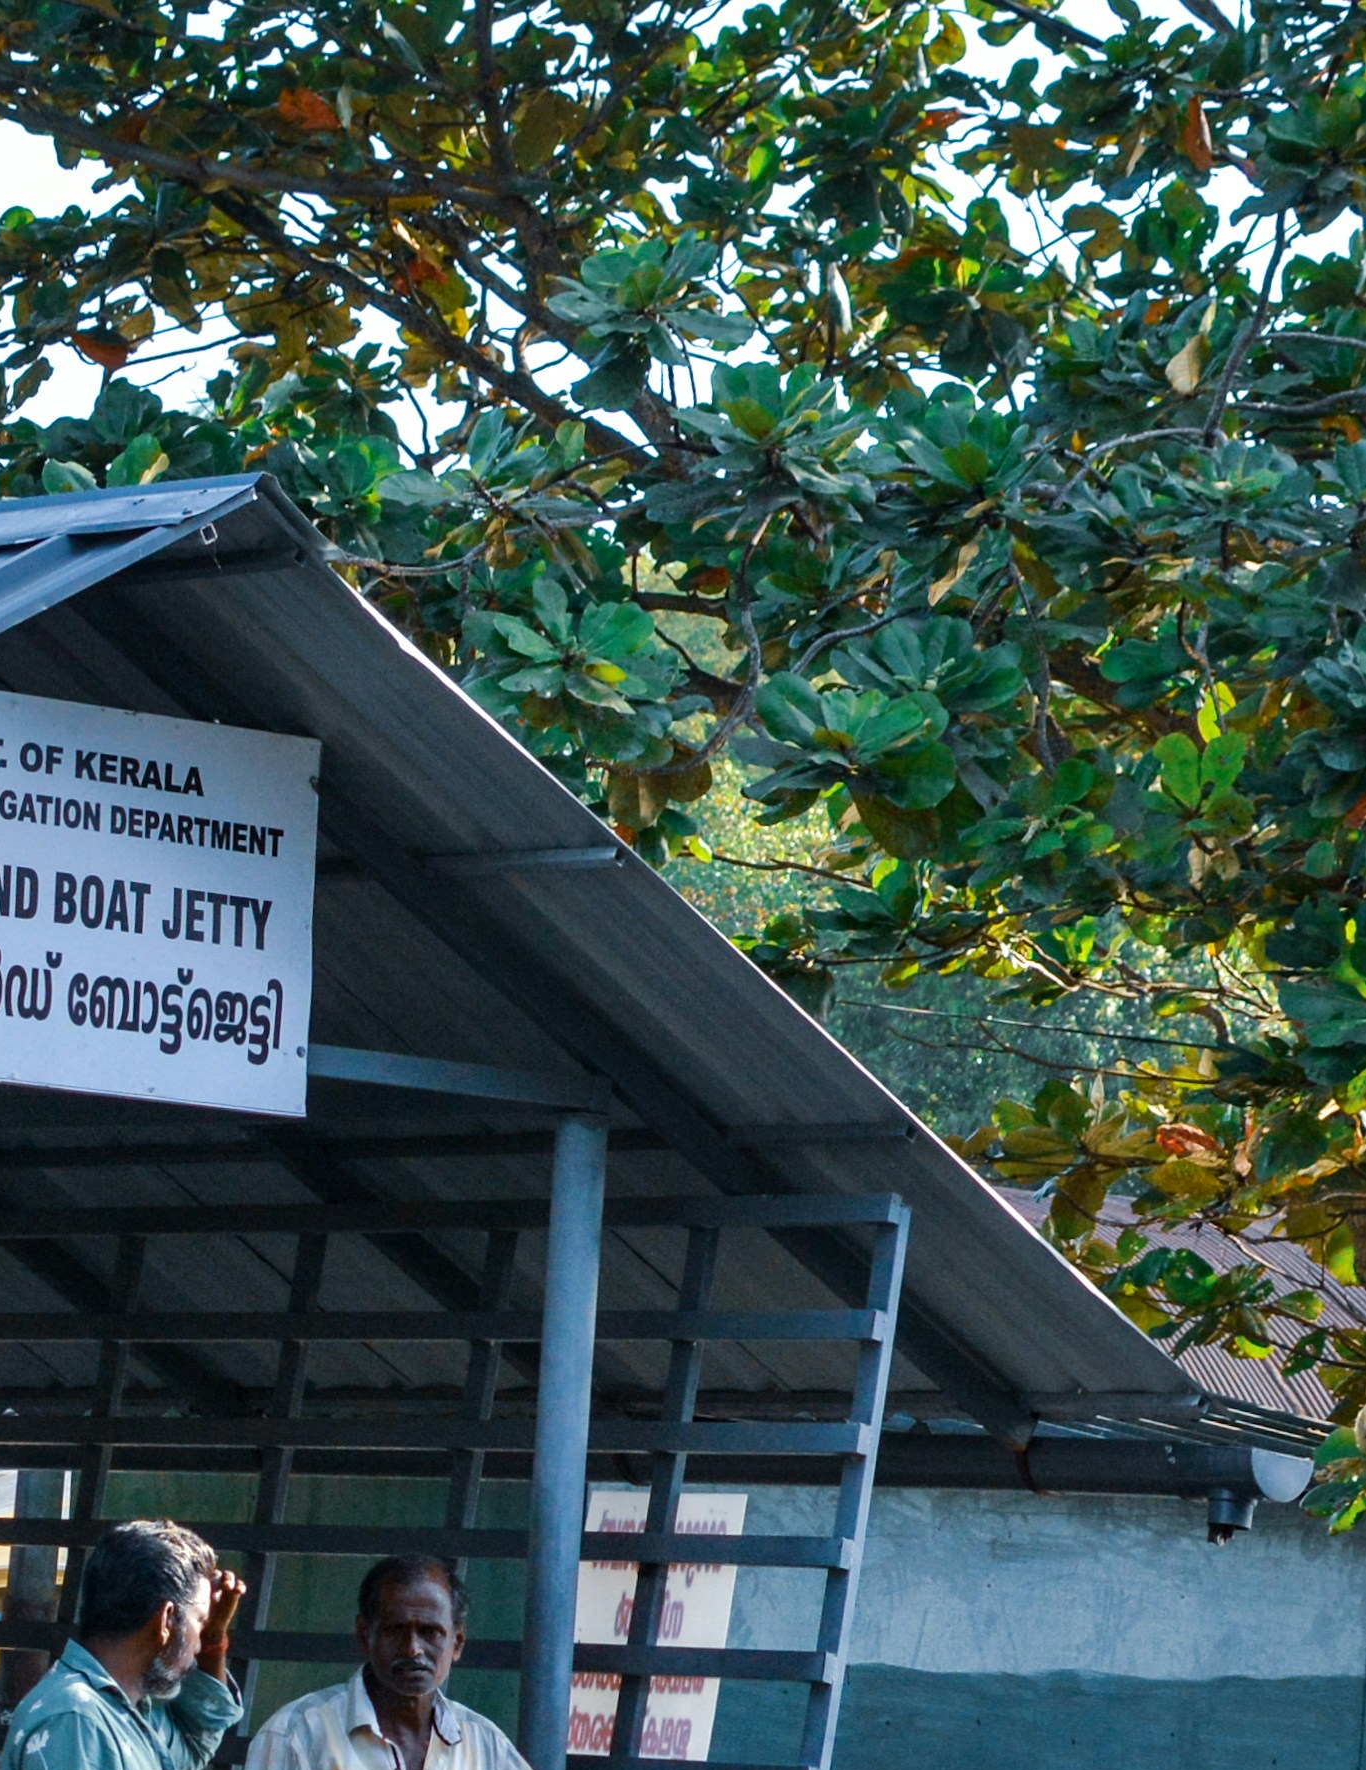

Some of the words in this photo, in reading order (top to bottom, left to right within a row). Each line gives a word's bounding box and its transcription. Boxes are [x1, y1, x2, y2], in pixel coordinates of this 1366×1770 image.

[20, 741, 64, 774] OF
[74, 750, 205, 797] KERALA
[110, 805, 285, 857] DEPARTMENT
[54, 872, 152, 935] BOAT
[162, 887, 273, 951] JETTY
